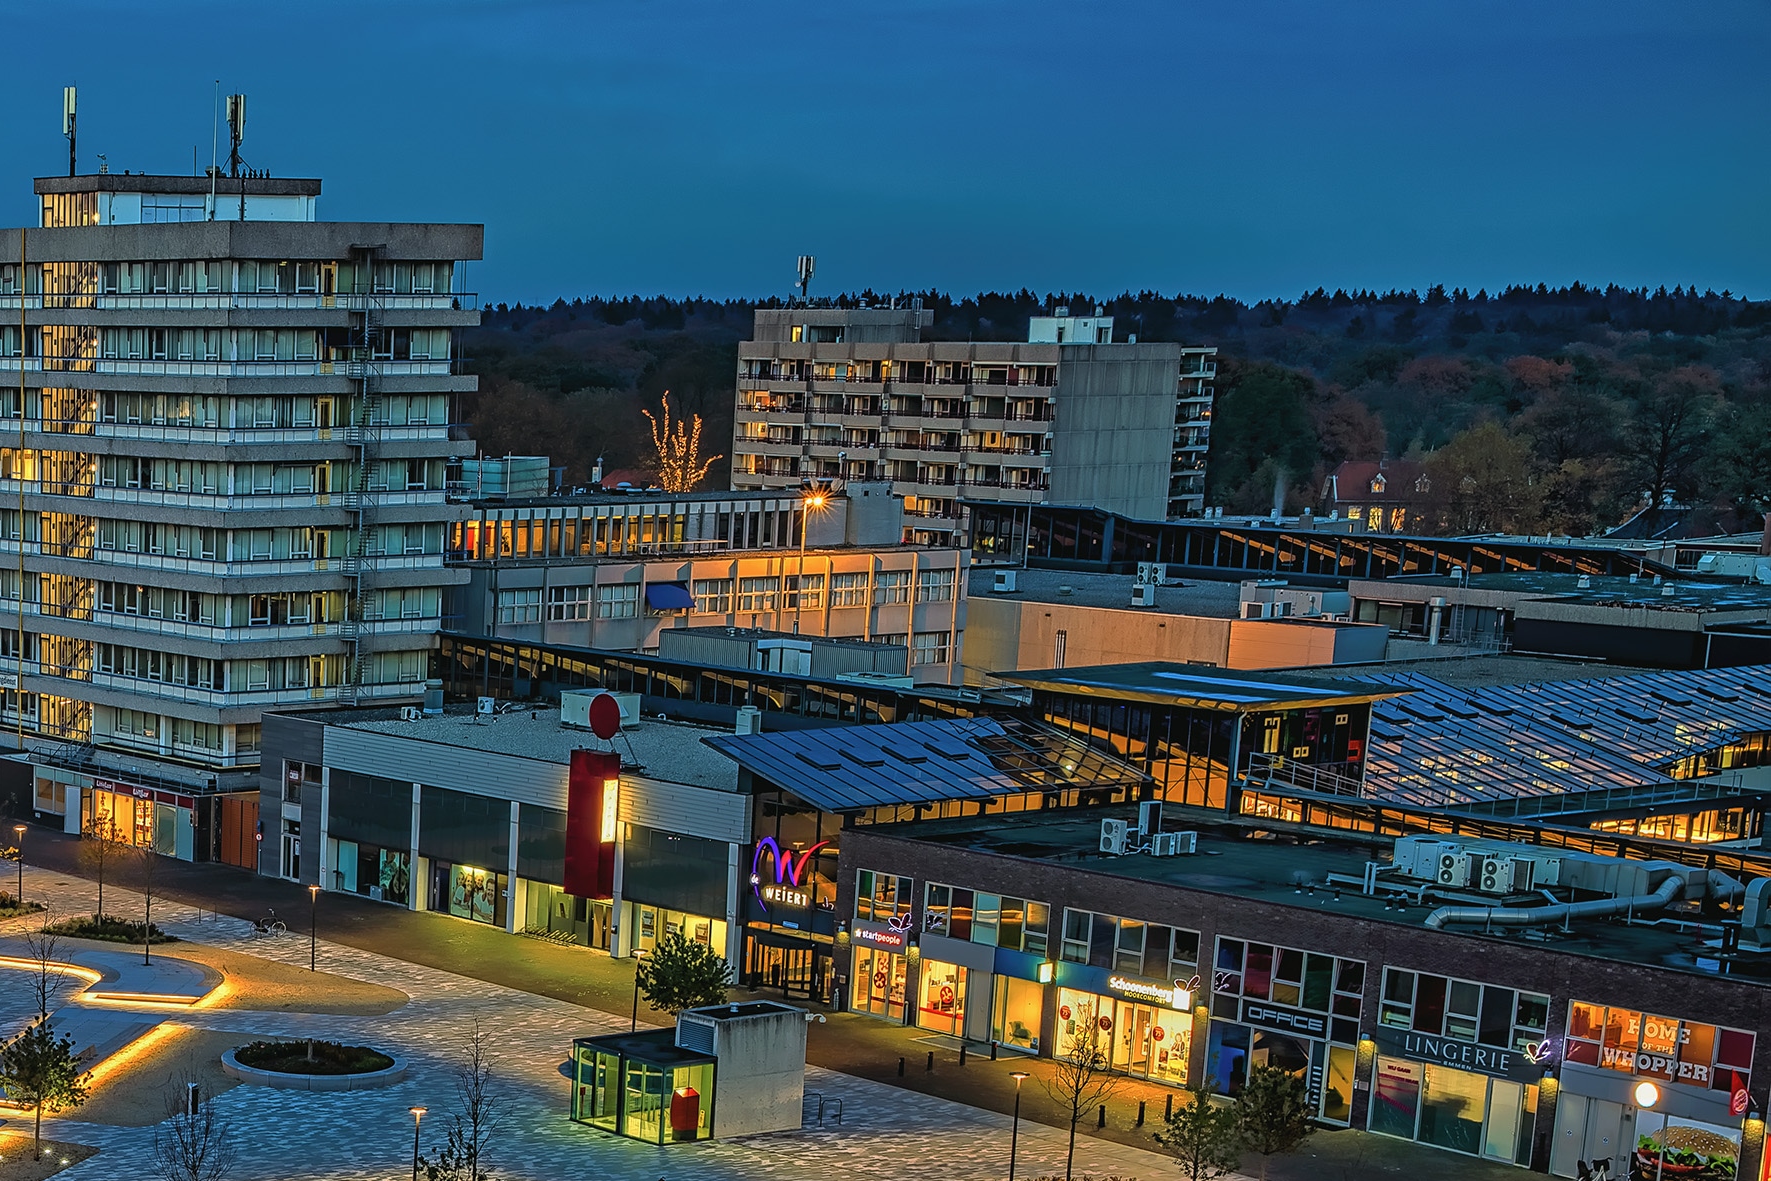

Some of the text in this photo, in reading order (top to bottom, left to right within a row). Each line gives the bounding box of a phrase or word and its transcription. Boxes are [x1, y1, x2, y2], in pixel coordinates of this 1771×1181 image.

[862, 929, 901, 945] startpeople
[1109, 977, 1173, 1002] Schoonenberg
[1124, 991, 1166, 1004] HOORCOMFORT
[1248, 1006, 1323, 1032] OFFICE
[1628, 1018, 1691, 1044] HOME
[1405, 1034, 1510, 1071] LINGERIE
[1642, 1041, 1675, 1055] OF THE
[1443, 1061, 1472, 1070] EMMEN
[1603, 1047, 1708, 1082] WHOPPER
